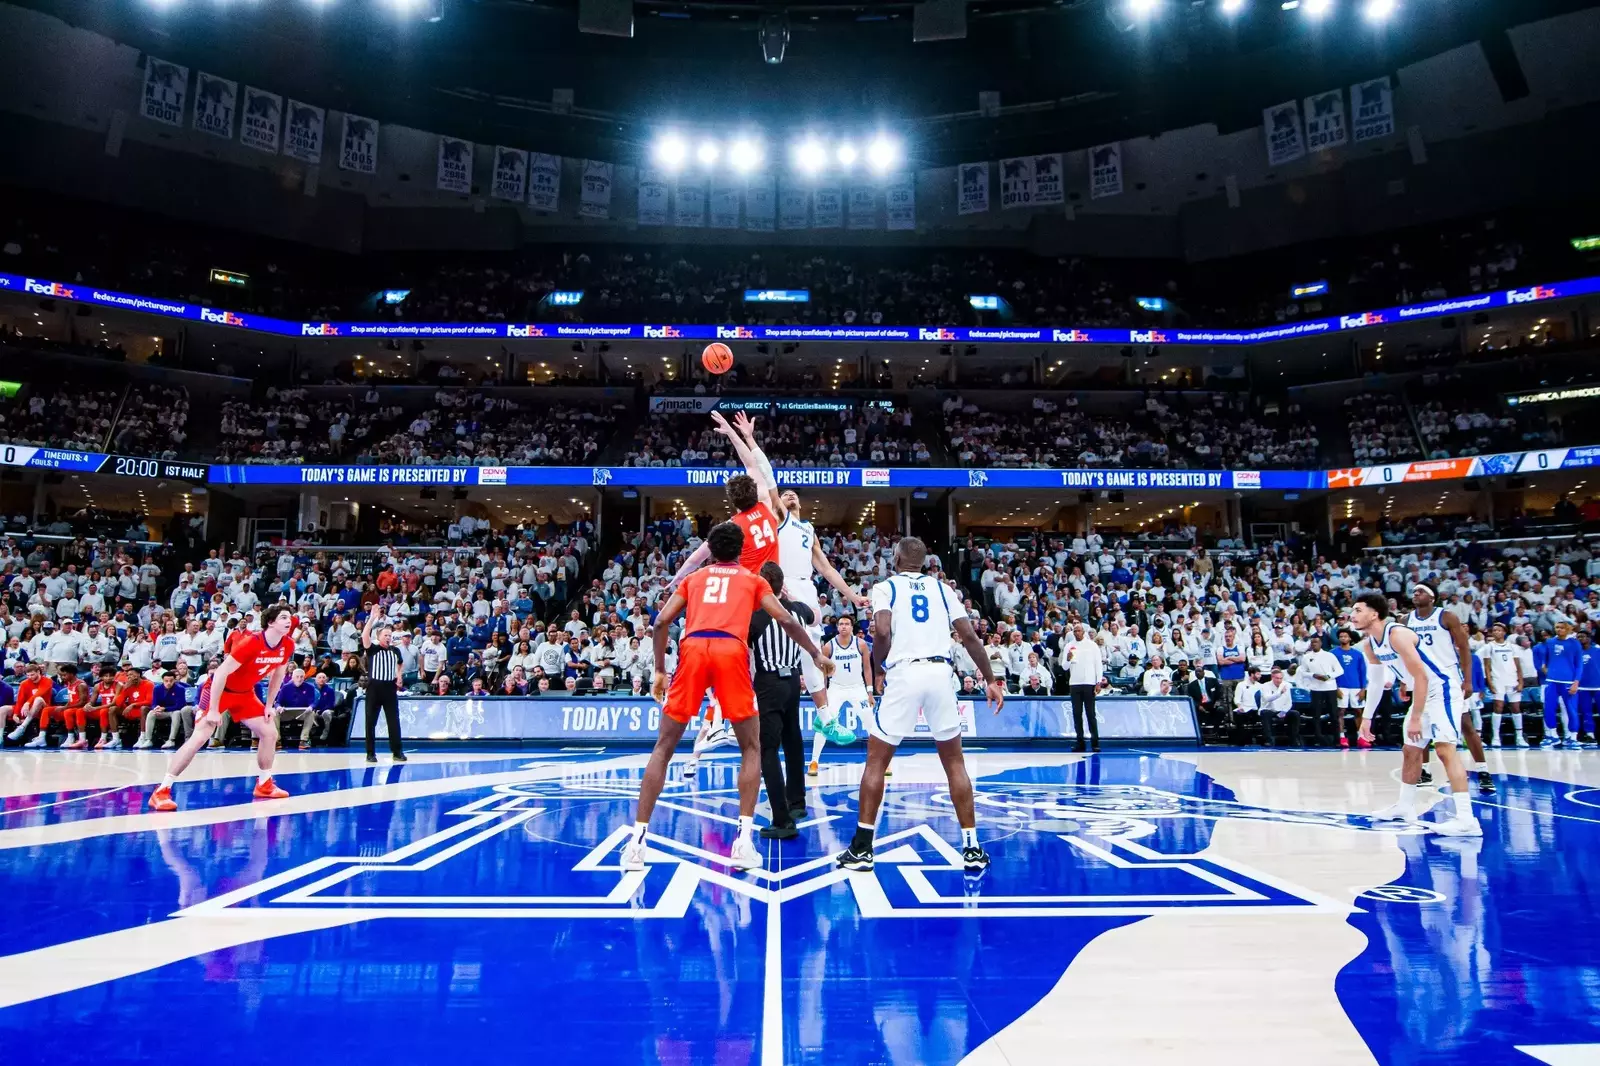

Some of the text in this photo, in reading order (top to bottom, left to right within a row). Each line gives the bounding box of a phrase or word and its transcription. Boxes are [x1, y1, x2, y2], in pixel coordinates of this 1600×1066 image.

[146, 83, 182, 105] NIT
[147, 105, 177, 123] 2001
[197, 100, 232, 120] NIT
[1358, 102, 1384, 118] NIT
[197, 112, 229, 127] 2002
[246, 117, 275, 132] NCAA
[1309, 115, 1341, 133] NIT
[246, 128, 274, 142] 2003
[290, 126, 317, 141] NCAA
[1355, 123, 1391, 139] 2021
[290, 136, 316, 149] 2004
[345, 139, 373, 154] NIT
[443, 161, 466, 172] NCAA
[1094, 166, 1117, 176] NCAA
[496, 172, 521, 182] NCAA
[1036, 175, 1059, 183] NCAA
[496, 181, 520, 190] 2007
[1002, 180, 1029, 193] NIT
[1003, 192, 1030, 205] 2010
[24, 278, 74, 299] FedEx
[1507, 285, 1556, 305] FedEx
[93, 291, 185, 314] fedex.com/pictureproof
[1399, 296, 1491, 317] fedex.com/pictureproof
[201, 307, 244, 327] FedEx
[1340, 312, 1383, 329] FedEx
[302, 323, 339, 335] FedEx
[351, 326, 365, 334] Shop
[376, 326, 389, 334] ship
[389, 326, 419, 335] confidently
[432, 326, 451, 335] picture
[452, 326, 467, 335] proof
[474, 326, 497, 335] delivery.
[507, 324, 545, 337] FedEx
[558, 327, 631, 336] fedex.com/pictureproof
[643, 325, 681, 338] FedEx
[716, 326, 754, 338] FedEx
[765, 329, 779, 337] Shop
[791, 329, 802, 337] ship
[802, 329, 832, 338] confidently
[833, 329, 845, 337] with
[845, 330, 864, 338] picture
[865, 330, 880, 338] proof
[887, 330, 909, 338] delivery.
[918, 328, 955, 340] FedEx
[969, 331, 1040, 339] fedex.com/pictureproof
[1053, 329, 1089, 342] FedEx
[1177, 332, 1191, 341] Shop
[1202, 333, 1213, 341] ship
[1214, 333, 1243, 341] confidently
[1244, 332, 1257, 340] with
[1258, 330, 1278, 339] picture
[1279, 327, 1296, 337] proof
[1296, 325, 1303, 333] of
[1303, 322, 1329, 332] delivery.
[1130, 330, 1167, 343] FedEx
[656, 398, 702, 410] Pinnacle
[5, 447, 15, 463] 0
[44, 451, 88, 463] TIMEOUTS: 4
[1538, 453, 1548, 469] 0
[31, 458, 53, 467] FOULS:
[116, 458, 158, 477] 20:00
[181, 467, 205, 479] HALF
[301, 468, 467, 482] TODAY'S GAME IS PRESENTED BY
[687, 470, 729, 484] TODAY'S
[777, 470, 833, 484] PRESENTED
[837, 471, 850, 484] BY
[1062, 472, 1221, 486] TODAY'S GAME IS PRESENTED BY
[1383, 467, 1392, 482] 0
[749, 519, 775, 549] 24
[801, 534, 809, 549] 2
[703, 576, 730, 603] 21
[911, 594, 929, 623] 8
[255, 656, 285, 664] CLEMSON
[835, 653, 858, 661] Memphis
[1502, 653, 1508, 662] 0
[258, 664, 271, 676] 4
[843, 662, 851, 673] 4
[562, 706, 641, 731] TODAY'S
